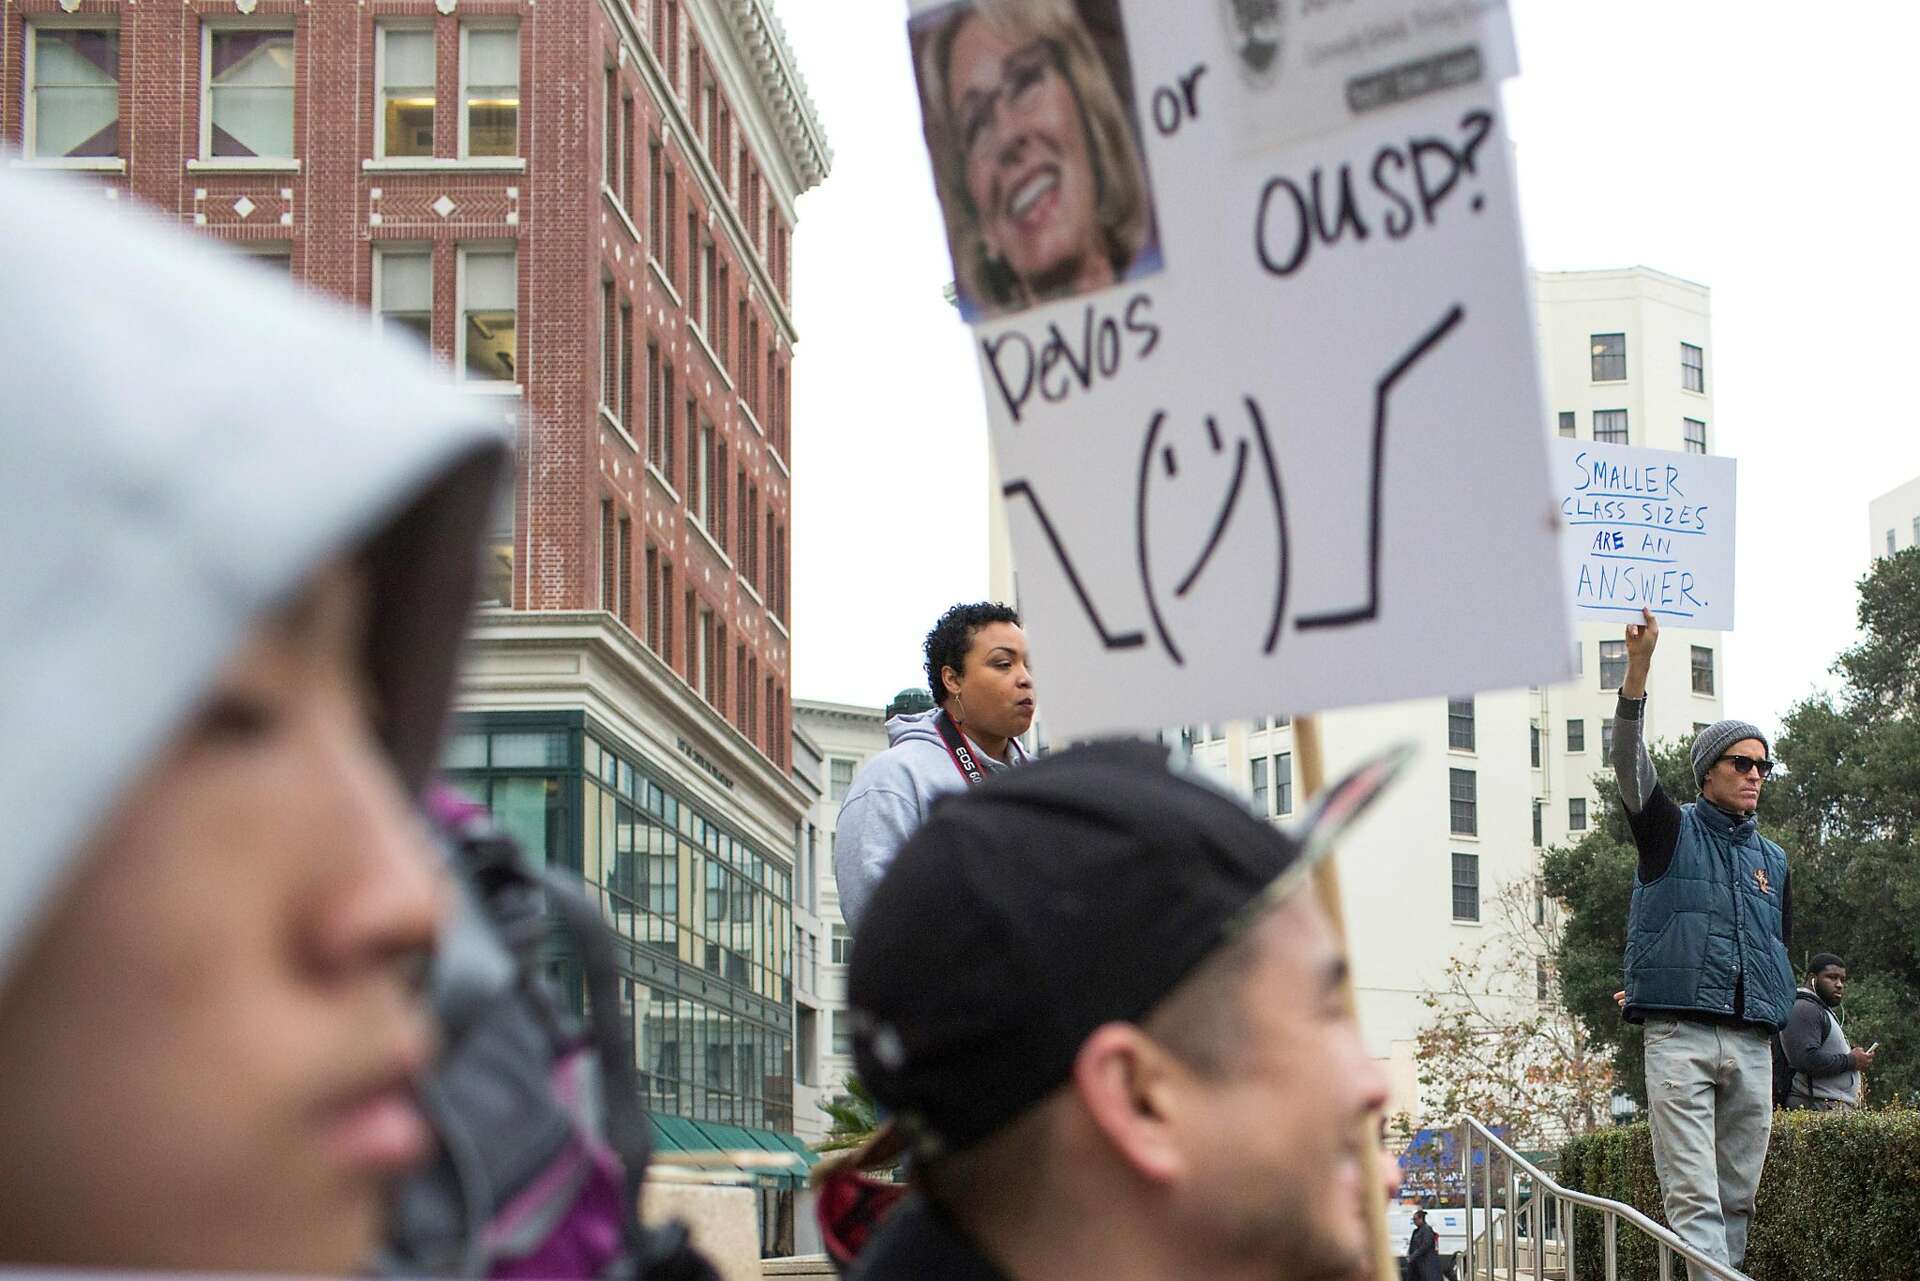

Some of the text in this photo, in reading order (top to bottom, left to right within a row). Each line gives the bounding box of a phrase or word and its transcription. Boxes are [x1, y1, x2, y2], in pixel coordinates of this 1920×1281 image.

[1153, 64, 1207, 137] or
[1256, 110, 1494, 277] OUSP?
[1574, 452, 1684, 497] SMALLER
[1560, 497, 1708, 530] CLASS SIZES
[1592, 531, 1671, 555] ARE AN
[1577, 564, 1709, 608] ANSWER.
[956, 746, 975, 770] EOS
